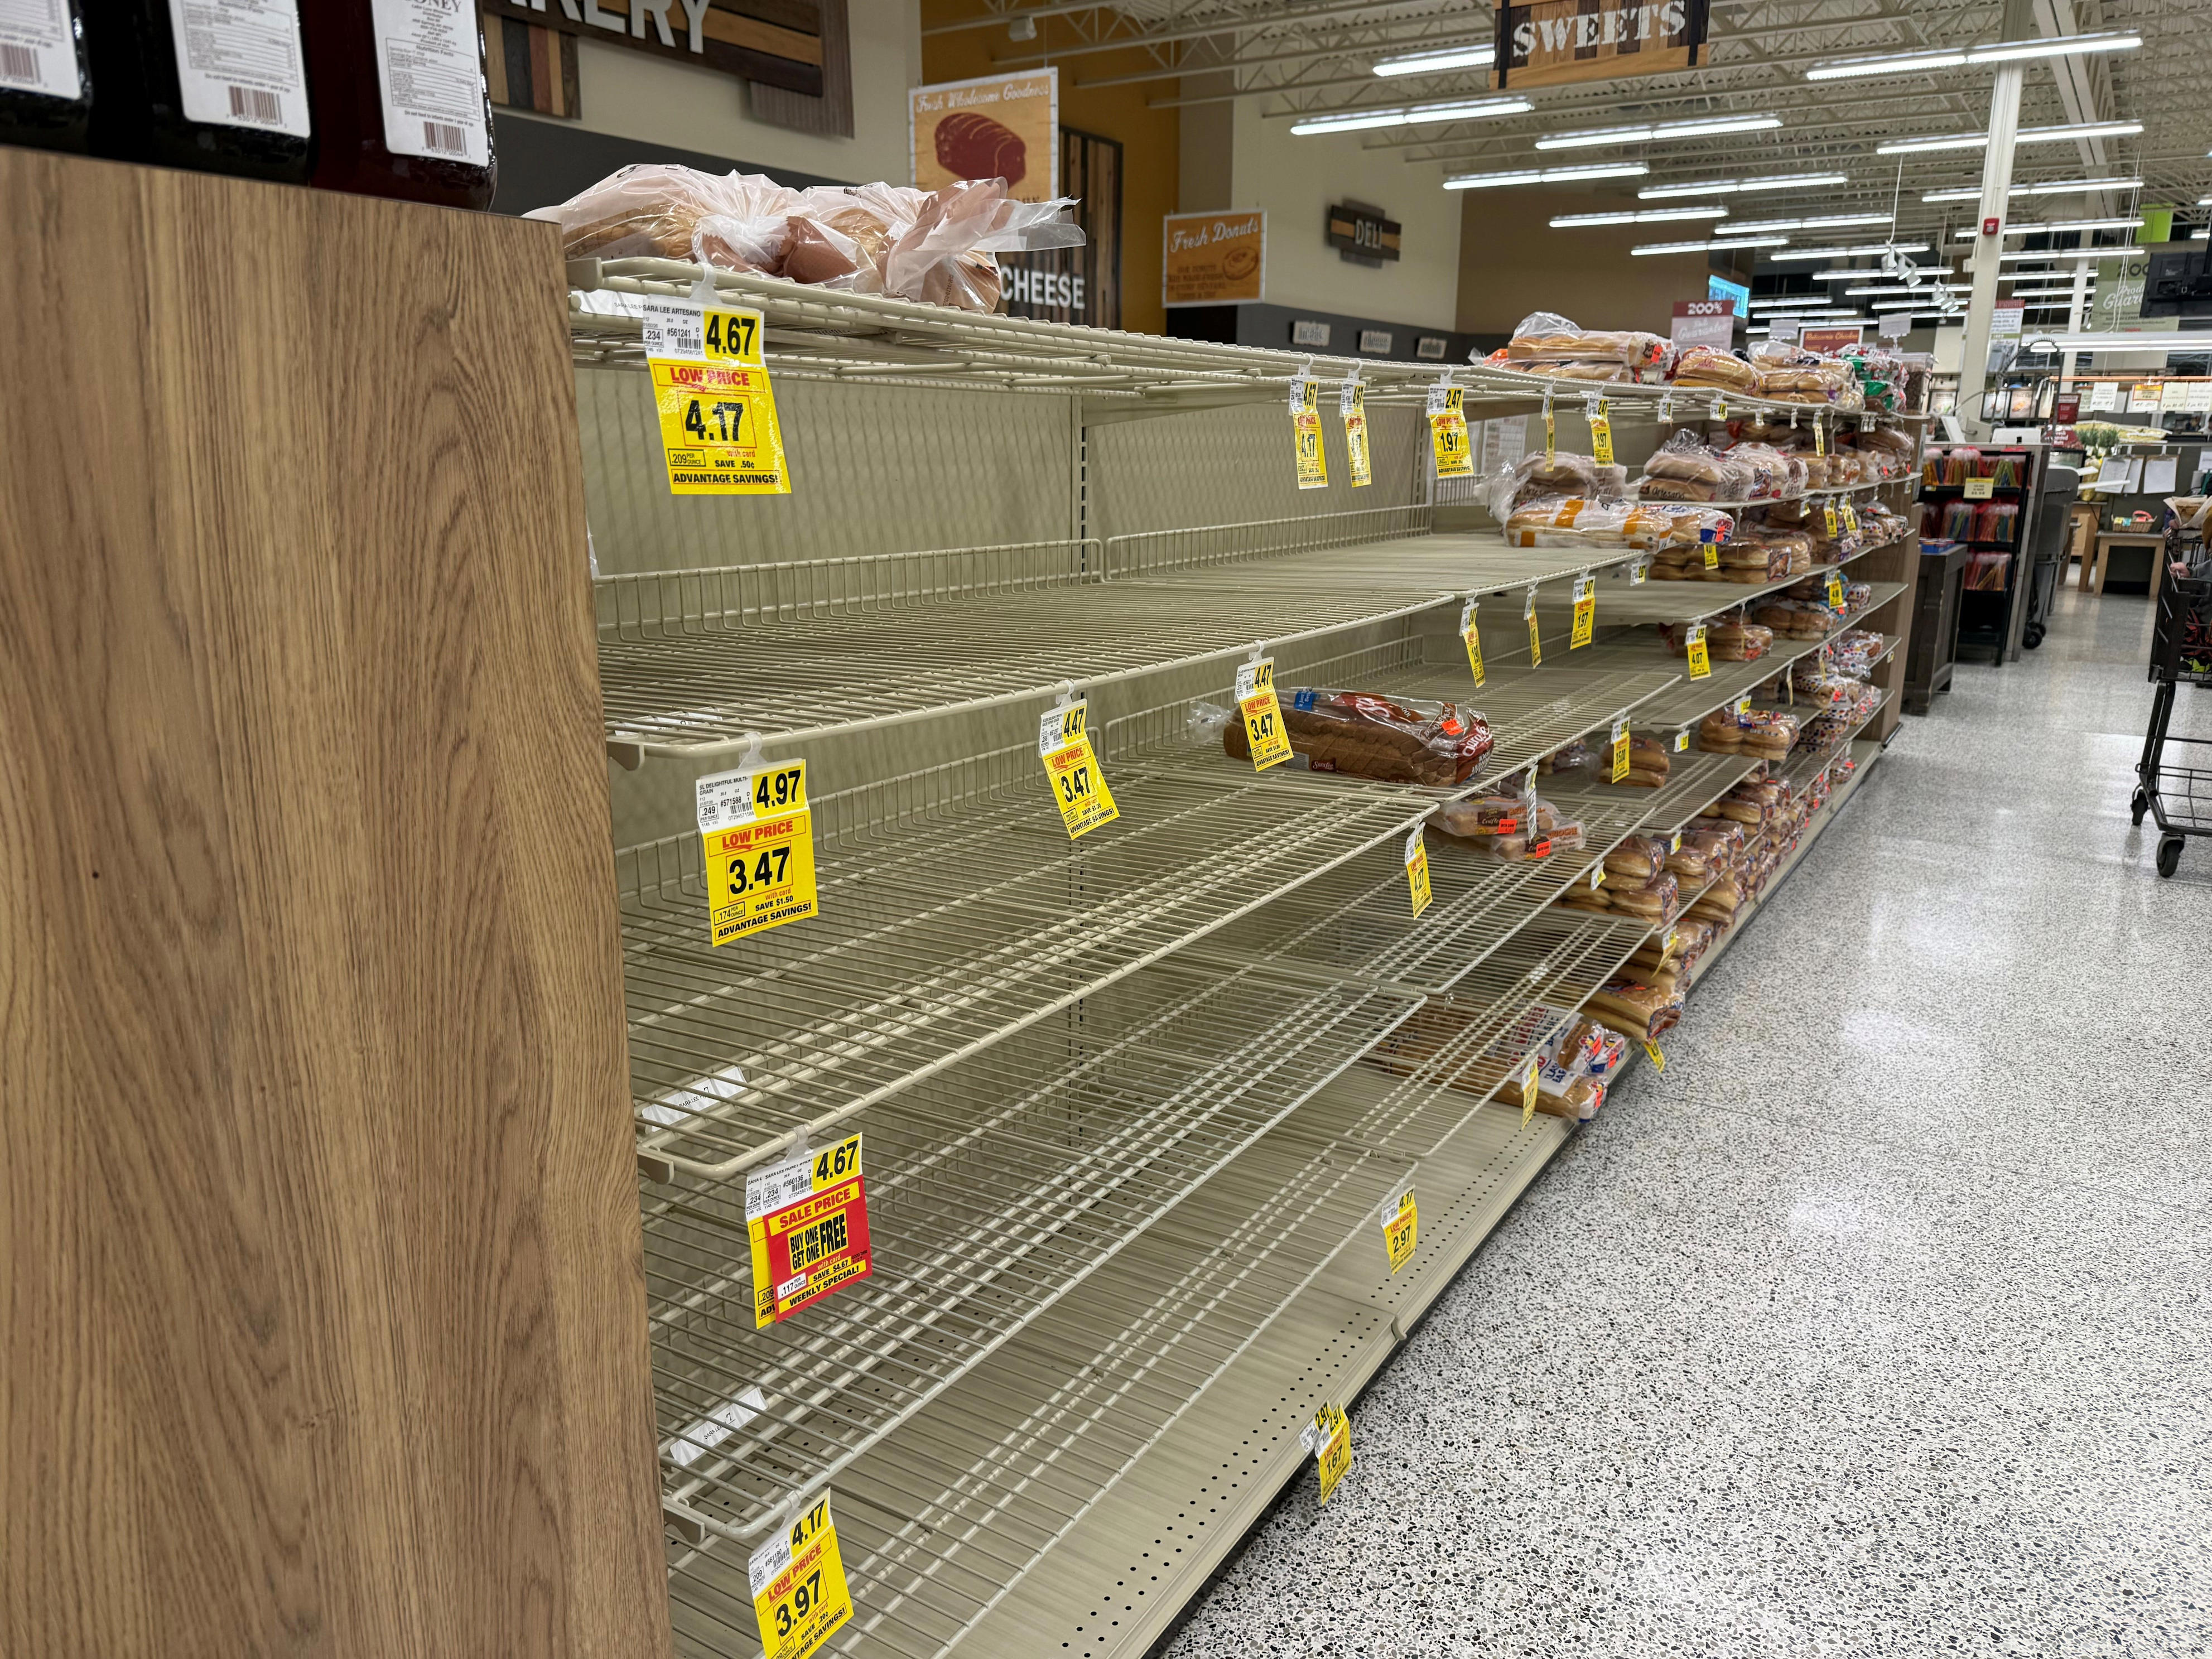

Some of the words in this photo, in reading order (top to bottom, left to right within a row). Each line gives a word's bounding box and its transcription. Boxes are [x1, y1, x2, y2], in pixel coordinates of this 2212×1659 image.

[406, 0, 461, 12] NEY
[1514, 0, 1685, 57] SWEETS
[416, 44, 440, 54] Nutrition
[917, 94, 943, 112] Fresh
[948, 88, 1000, 108] Wholesome
[1004, 81, 1049, 101] Goodness
[1170, 226, 1208, 253] Fresh
[1212, 216, 1258, 243] Donuts
[1355, 218, 1382, 250] DELI
[1000, 265, 1086, 310] CHEESE
[1688, 301, 1723, 315] 200%
[643, 305, 658, 313] SARA
[672, 308, 701, 317] ARTESANO
[706, 315, 756, 356] 4.67
[645, 330, 661, 340] .234
[667, 327, 691, 338] #561241
[671, 367, 702, 383] LOW
[707, 370, 750, 386] PRICE
[1303, 383, 1317, 406] 4.67
[1445, 389, 1462, 409] 2.47
[686, 400, 744, 441] 4.17
[1302, 433, 1315, 457] 4.17
[1440, 432, 1458, 452] 1.97
[1597, 432, 1607, 448] 1.97
[672, 454, 687, 464] .209
[741, 460, 754, 469] .50¢
[673, 473, 732, 483] ADVANTAGE
[733, 474, 778, 484] SAVINGS!
[1578, 611, 1589, 629] 1.97
[1692, 652, 1703, 665] 4.07
[1255, 664, 1272, 688] 4.47
[1245, 702, 1255, 712] LOW
[1256, 697, 1271, 707] PRICE
[1064, 708, 1085, 737] 4.47
[1251, 713, 1273, 741] 3.47
[1052, 756, 1066, 768] LOW
[1067, 747, 1084, 761] PRICE
[1273, 749, 1290, 759] SAVINGS!
[1313, 760, 1326, 770] Sara
[1326, 761, 1334, 770] Lee
[756, 769, 801, 808] 4.97
[1061, 766, 1091, 803] 3.47
[702, 806, 715, 816] .249
[720, 796, 741, 807] #571588
[1070, 818, 1092, 833] ADVANTAGE
[1092, 808, 1115, 823] SAVINGS!
[722, 830, 751, 850] LOW
[755, 821, 793, 841] PRICE
[728, 846, 790, 895] 3.47
[1414, 867, 1424, 893] 4.27
[755, 901, 773, 912] SAVE
[776, 895, 793, 906] $1.50
[765, 891, 778, 901] with
[779, 887, 791, 898] card
[717, 910, 731, 922] .174
[718, 914, 768, 938] ADVANTAGE
[770, 902, 811, 920] SAVINGS!
[731, 909, 743, 918] OUNCE
[816, 1140, 859, 1181] 4.67
[783, 1175, 803, 1188] #560136
[748, 1194, 761, 1205] .234
[765, 1188, 778, 1199] .234
[1399, 1188, 1414, 1209] 4.17
[780, 1210, 812, 1229] SALE
[815, 1188, 851, 1213] PRICE
[1390, 1221, 1400, 1233] LOW
[1400, 1212, 1412, 1225] PRICE
[790, 1234, 803, 1254] BUY
[805, 1227, 818, 1245] ONE
[819, 1213, 847, 1257] FREE
[1393, 1224, 1410, 1254] 2.97
[792, 1251, 805, 1271] GET
[806, 1244, 820, 1263] ONE
[817, 1260, 829, 1270] with
[830, 1253, 841, 1264] card
[813, 1269, 830, 1282] SAVE
[833, 1259, 848, 1272] $4.67
[780, 1282, 794, 1297] .117
[789, 1284, 821, 1307] WEEKLY
[823, 1265, 859, 1288] SPECIAL!
[794, 1279, 806, 1289] OUNCE
[760, 1288, 774, 1303] .209
[1315, 1401, 1330, 1431] 2.97
[1328, 1403, 1342, 1433] 2.97
[704, 1429, 715, 1440] SARA
[1327, 1443, 1343, 1475] 1.67
[792, 1498, 825, 1547] 4.17
[765, 1547, 782, 1567] #561190
[752, 1569, 763, 1584] .209
[768, 1576, 791, 1603] LOW
[793, 1543, 822, 1581] PRICE
[776, 1569, 821, 1637] 3.97
[808, 1612, 818, 1624] with
[818, 1601, 829, 1614] card
[801, 1623, 815, 1640] SAVE
[818, 1612, 828, 1624] .20¢
[814, 1607, 845, 1641] SAVINGS!
